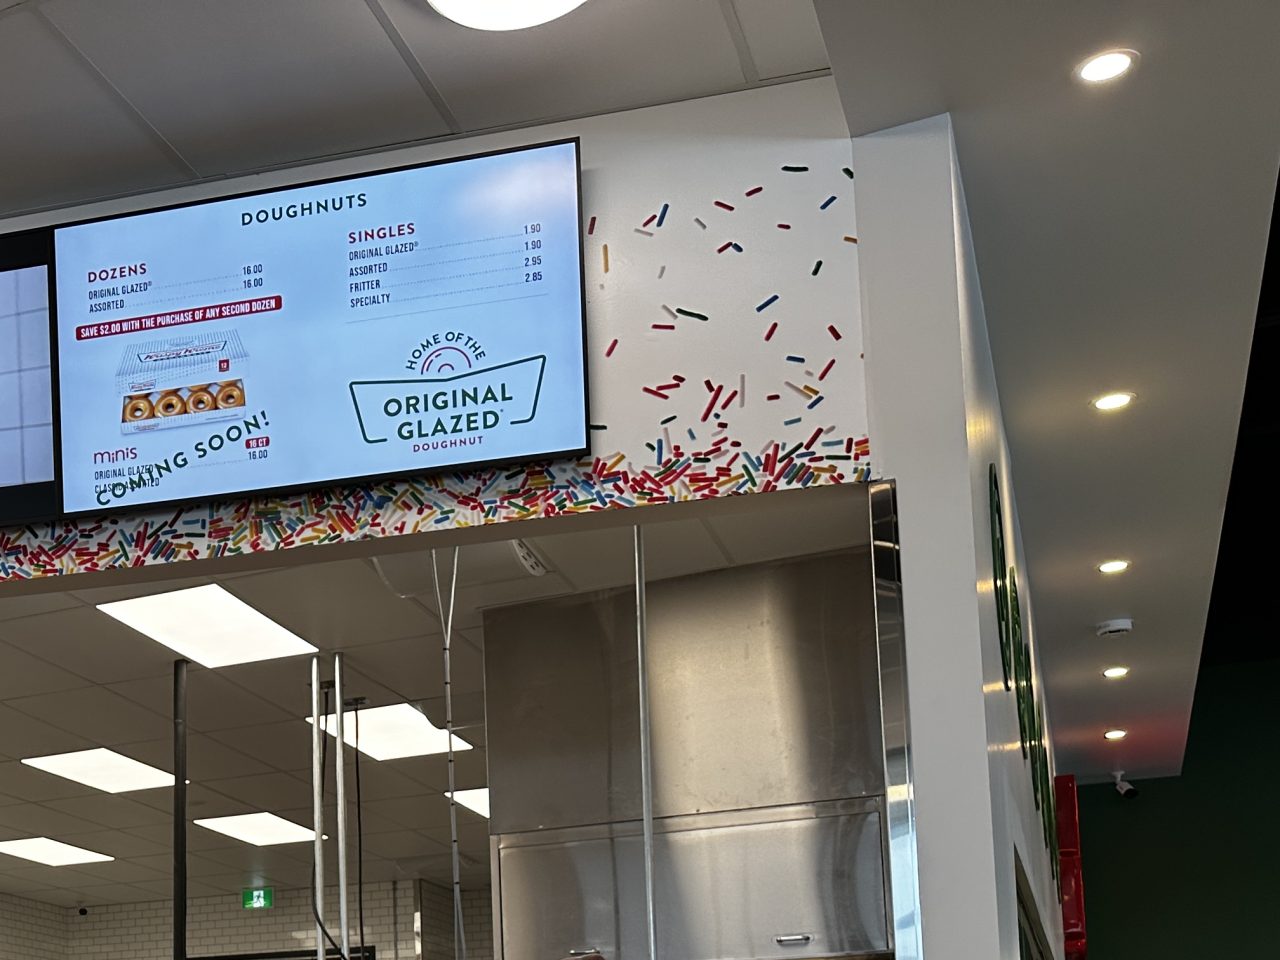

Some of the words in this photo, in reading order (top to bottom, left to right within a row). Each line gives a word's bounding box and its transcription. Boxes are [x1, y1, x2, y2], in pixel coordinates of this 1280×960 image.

[242, 193, 367, 226] DOUGHNUTS
[348, 223, 415, 244] SINGLES
[349, 247, 383, 261] ORIGINAL
[524, 223, 541, 235] 1.90
[88, 263, 147, 283] DOZENS
[349, 262, 388, 277] ASSORTED
[525, 239, 541, 251] 1.90
[350, 279, 380, 293] FRITTER
[524, 255, 542, 267] 2.95
[88, 287, 120, 300] ORIGINAL
[243, 264, 263, 275] 16.00
[89, 299, 124, 313] ASSORTED
[243, 277, 263, 289] 16.00
[350, 293, 390, 308] SPECIALTY
[81, 326, 98, 338] SAVE
[100, 323, 121, 335] $2.00
[122, 320, 140, 331] WITH
[141, 317, 155, 328] THE
[157, 311, 193, 326] PURCHASE
[195, 310, 203, 320] OF
[206, 307, 220, 318] ANY
[222, 303, 250, 316] SECOND
[252, 299, 275, 311] DOZEN
[405, 333, 442, 372] HOME
[445, 331, 464, 342] OF
[464, 336, 486, 360] THE
[383, 383, 513, 417] ORIGINAL
[94, 447, 137, 464] minis
[97, 452, 188, 505] COMING
[194, 410, 270, 459] SOON!
[249, 439, 257, 448] 16
[258, 438, 266, 447] CT
[413, 436, 483, 453] DOUGHNUT
[94, 468, 126, 480] ORIGINAL
[248, 449, 268, 460] 16.00
